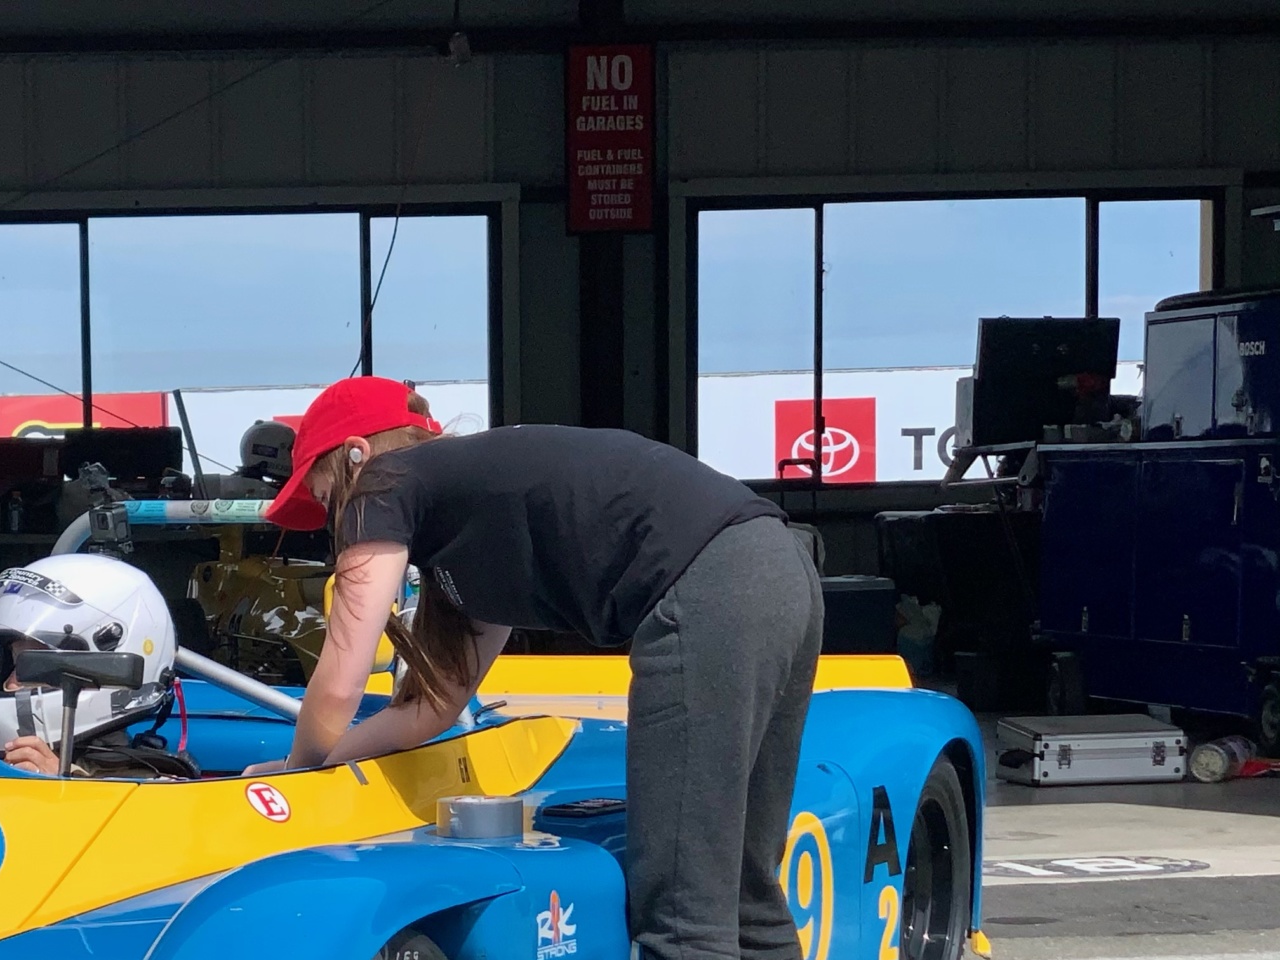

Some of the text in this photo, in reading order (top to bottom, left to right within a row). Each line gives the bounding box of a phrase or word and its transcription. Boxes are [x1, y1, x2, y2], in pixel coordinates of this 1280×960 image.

[586, 54, 633, 91] NO
[582, 95, 638, 111] FUEL IN
[576, 115, 644, 131] GARAGES
[577, 148, 644, 161] FUEL & FUEL
[578, 163, 643, 176] CONTAINERS
[587, 178, 634, 191] MUST BE
[590, 193, 631, 205] STORED
[588, 208, 633, 220] OUTSIDE
[1239, 341, 1266, 357] BOSCH
[251, 787, 286, 816] E
[863, 785, 902, 884] A
